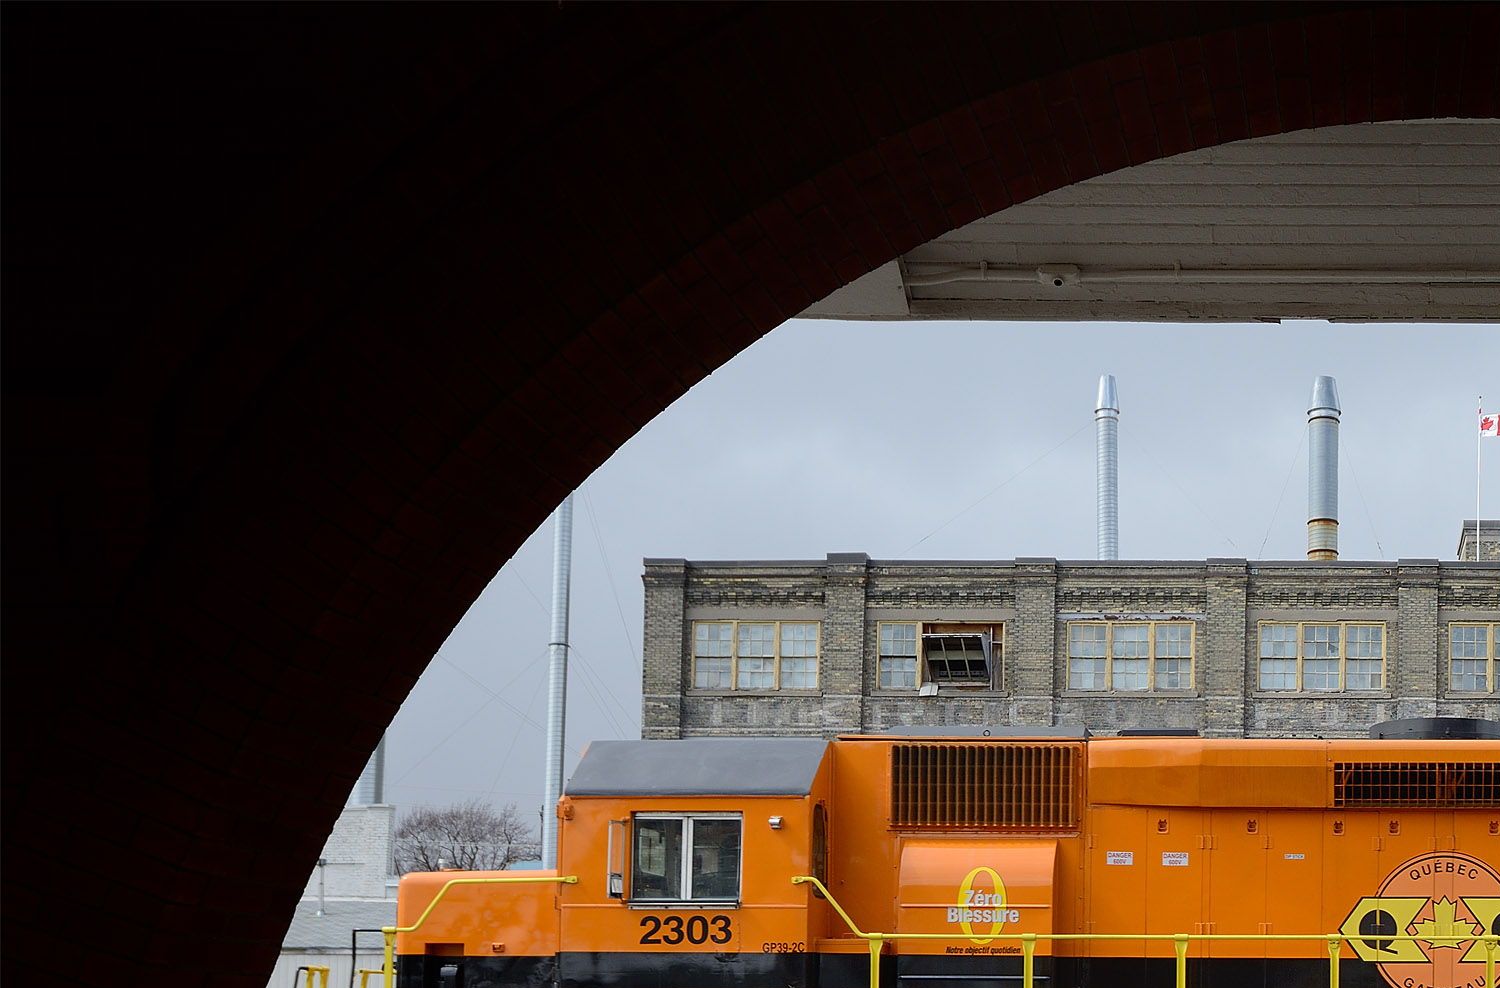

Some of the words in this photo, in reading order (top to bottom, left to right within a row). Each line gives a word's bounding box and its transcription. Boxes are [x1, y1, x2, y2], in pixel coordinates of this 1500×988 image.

[1409, 860, 1479, 881] QUÉBEC
[964, 889, 1003, 907] Zéro
[947, 907, 1020, 923] Blessure
[639, 915, 732, 945] 2303
[762, 942, 805, 953] GP39-2C
[946, 946, 963, 954] Notre
[965, 946, 990, 955] objectif
[991, 946, 1021, 955] quotidien
